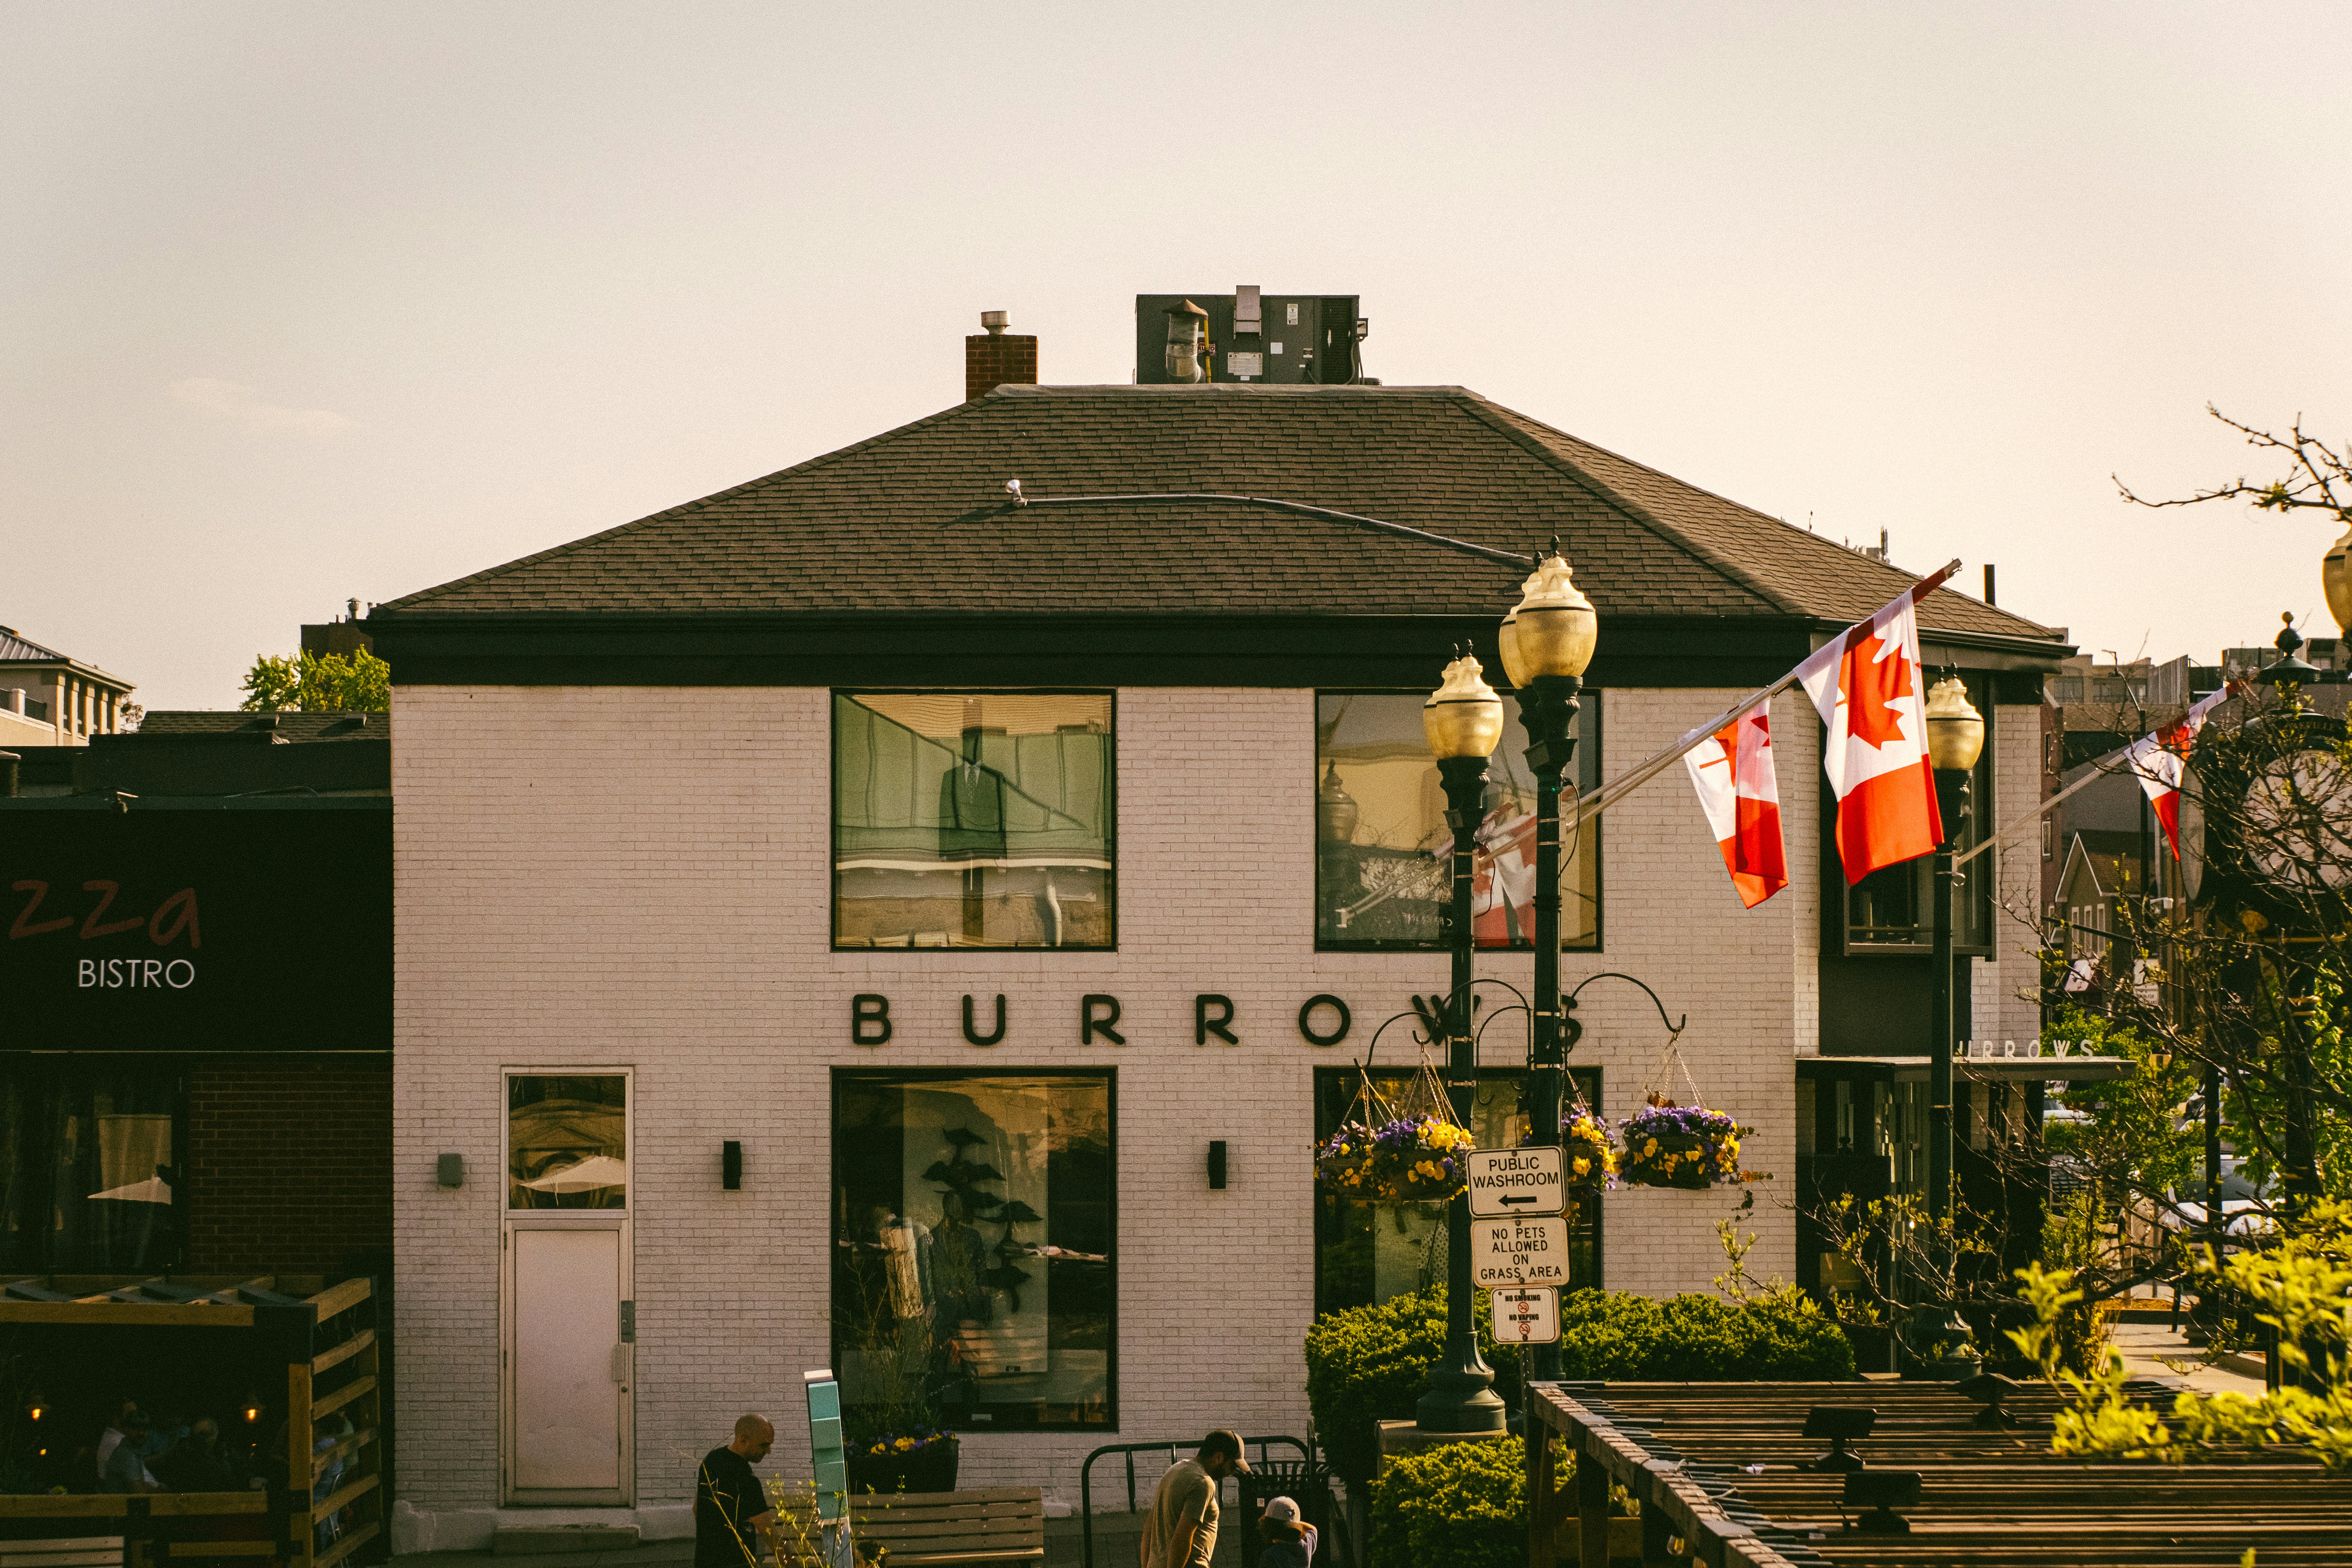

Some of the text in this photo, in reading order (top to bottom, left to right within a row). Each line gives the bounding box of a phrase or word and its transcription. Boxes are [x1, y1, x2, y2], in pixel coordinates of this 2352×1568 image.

[78, 959, 195, 988] BISTRO
[852, 993, 1582, 1046] BURROWS
[1959, 1039, 2094, 1062] URROWS
[1489, 1157, 1539, 1172] PUBLIC
[1473, 1172, 1558, 1188] WASHROOM
[1492, 1227, 1545, 1239] NO PETS
[1492, 1240, 1548, 1253] ALLOWED
[1513, 1254, 1529, 1265] ON
[1481, 1266, 1562, 1280] GRASS AREA
